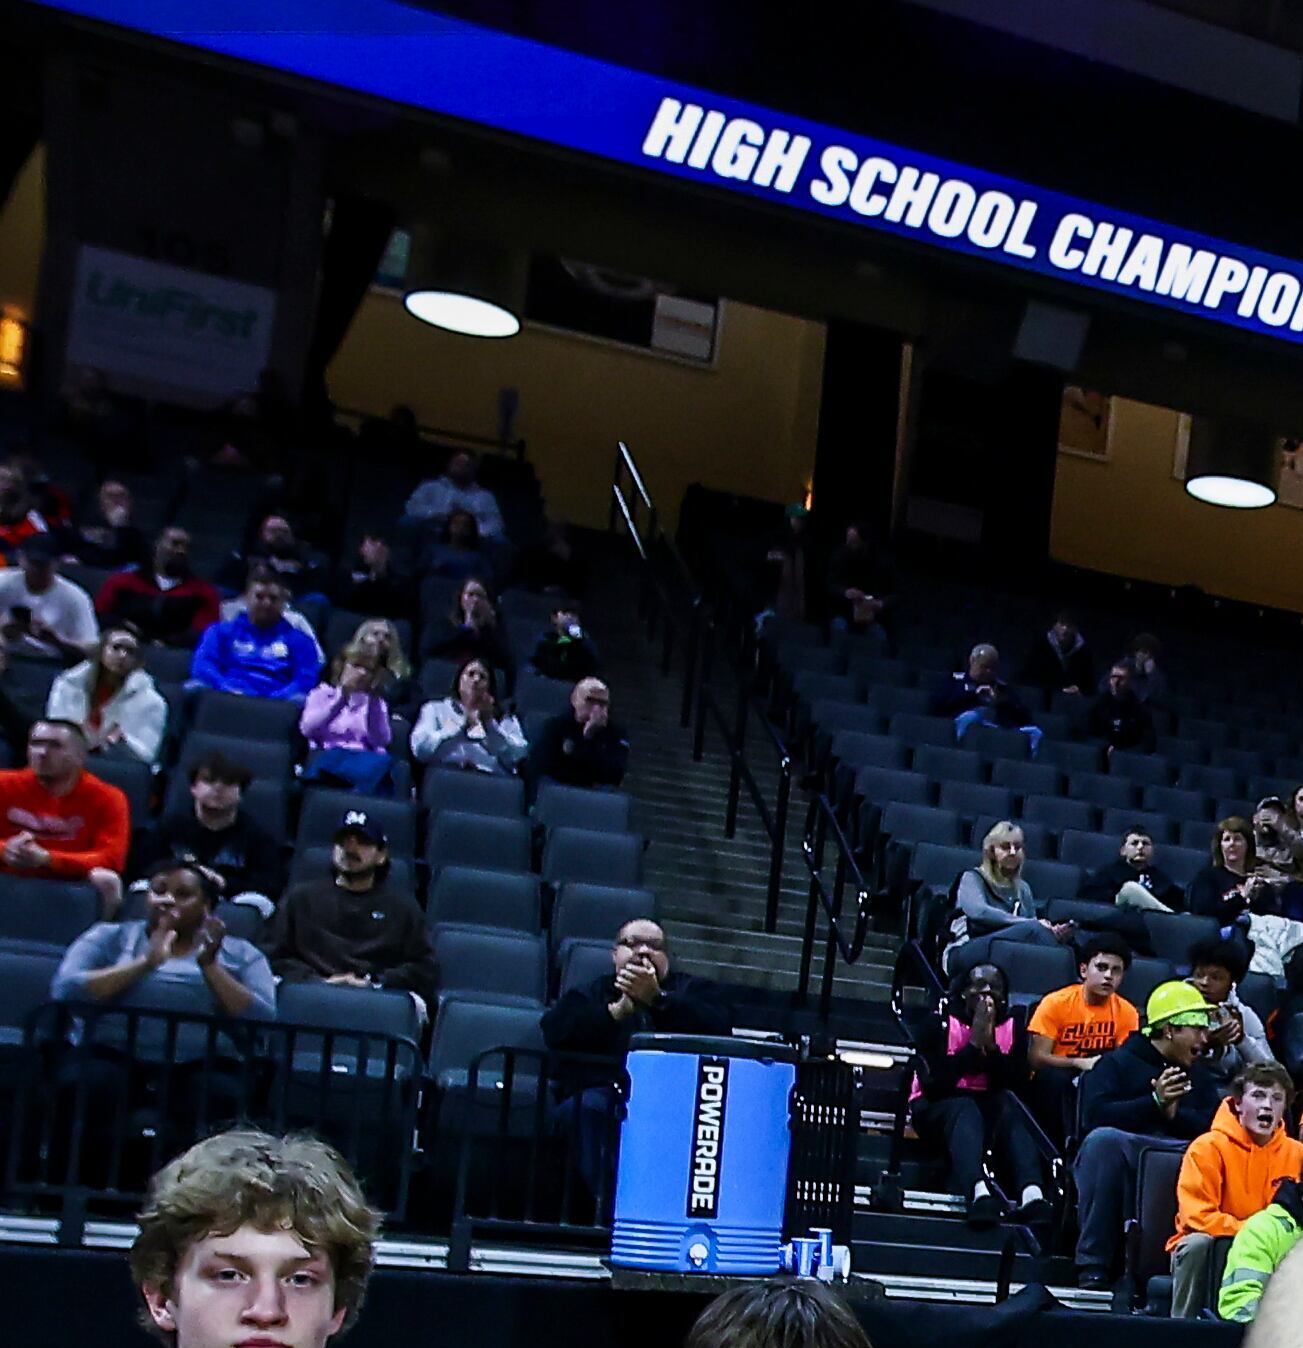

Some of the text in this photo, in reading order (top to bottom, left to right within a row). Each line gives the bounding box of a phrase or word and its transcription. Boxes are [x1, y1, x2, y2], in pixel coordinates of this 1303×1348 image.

[641, 96, 812, 194] HIGH
[809, 144, 1039, 260] SCHOOL
[690, 1064, 726, 1210] POWERADE
